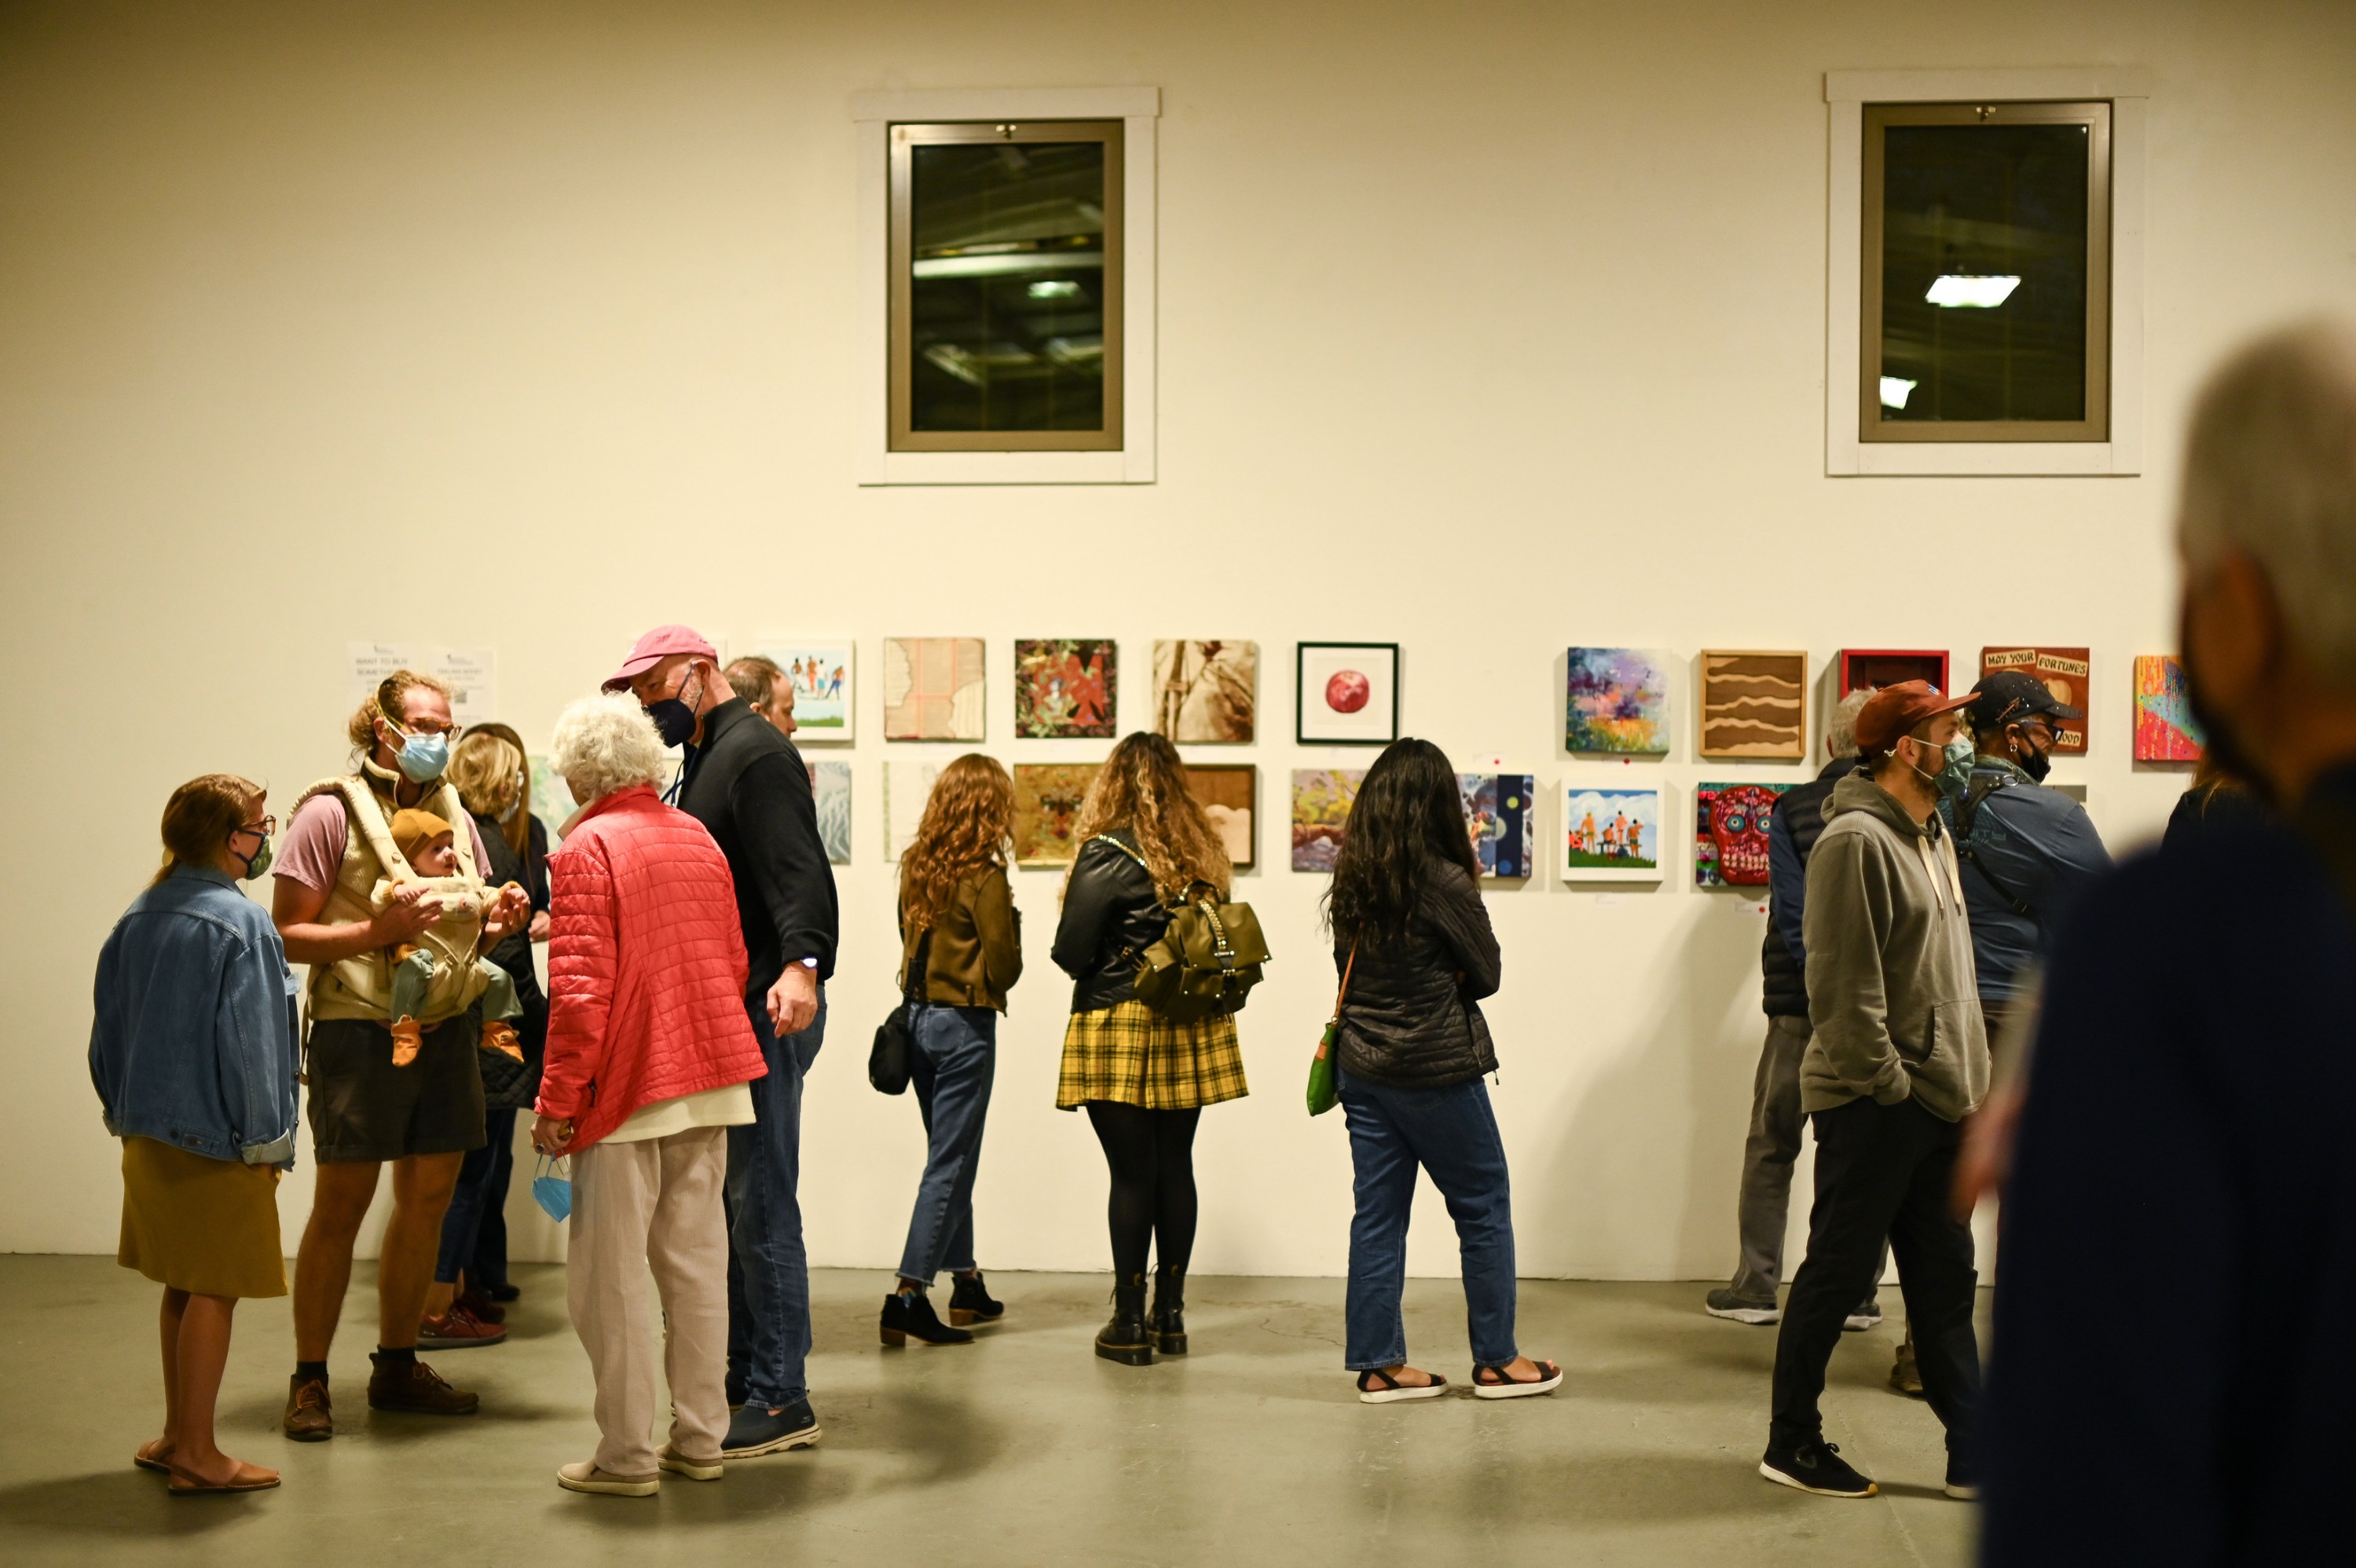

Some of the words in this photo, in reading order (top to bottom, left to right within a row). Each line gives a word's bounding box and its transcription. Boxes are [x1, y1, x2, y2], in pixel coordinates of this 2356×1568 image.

[1988, 655, 2006, 665] MAY
[2010, 651, 2034, 663] YOUR
[2039, 657, 2087, 674] FORTUNES
[2059, 732, 2080, 744] OOD
